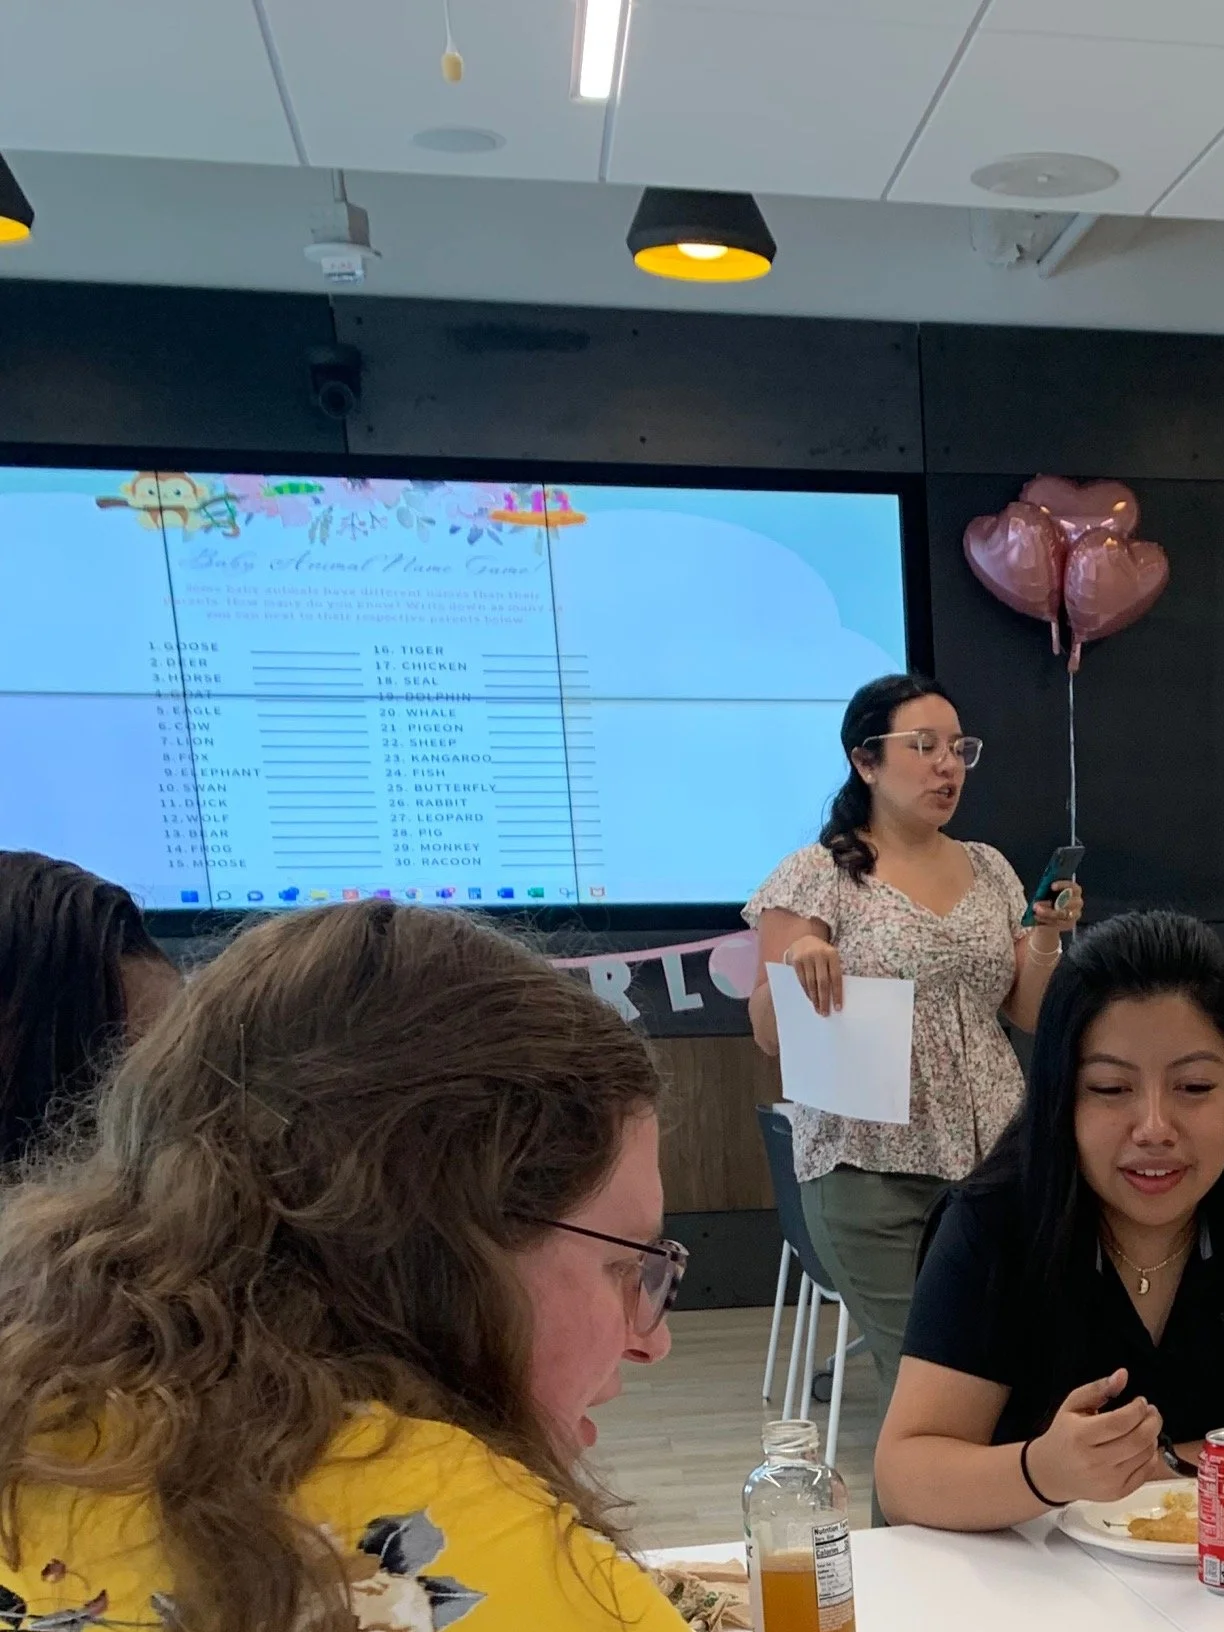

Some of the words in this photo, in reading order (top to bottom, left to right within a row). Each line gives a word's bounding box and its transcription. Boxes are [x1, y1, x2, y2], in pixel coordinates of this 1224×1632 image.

[400, 645, 444, 656] TIGER
[402, 662, 467, 672] CHICKEN
[404, 676, 439, 686] SEAL
[405, 692, 472, 703] DOLPHIN
[405, 708, 457, 718] WHALE
[408, 724, 464, 733] PIGEON
[410, 739, 457, 748] SHEEP
[411, 754, 492, 764] KANGAROO
[413, 769, 445, 778] FISH
[414, 784, 497, 793] BUTTERFLY
[416, 799, 468, 808] RABBIT
[417, 814, 484, 823] LEOPARD
[418, 829, 443, 838] PIG
[420, 844, 481, 853] MONKEY
[422, 858, 482, 868] RACOON
